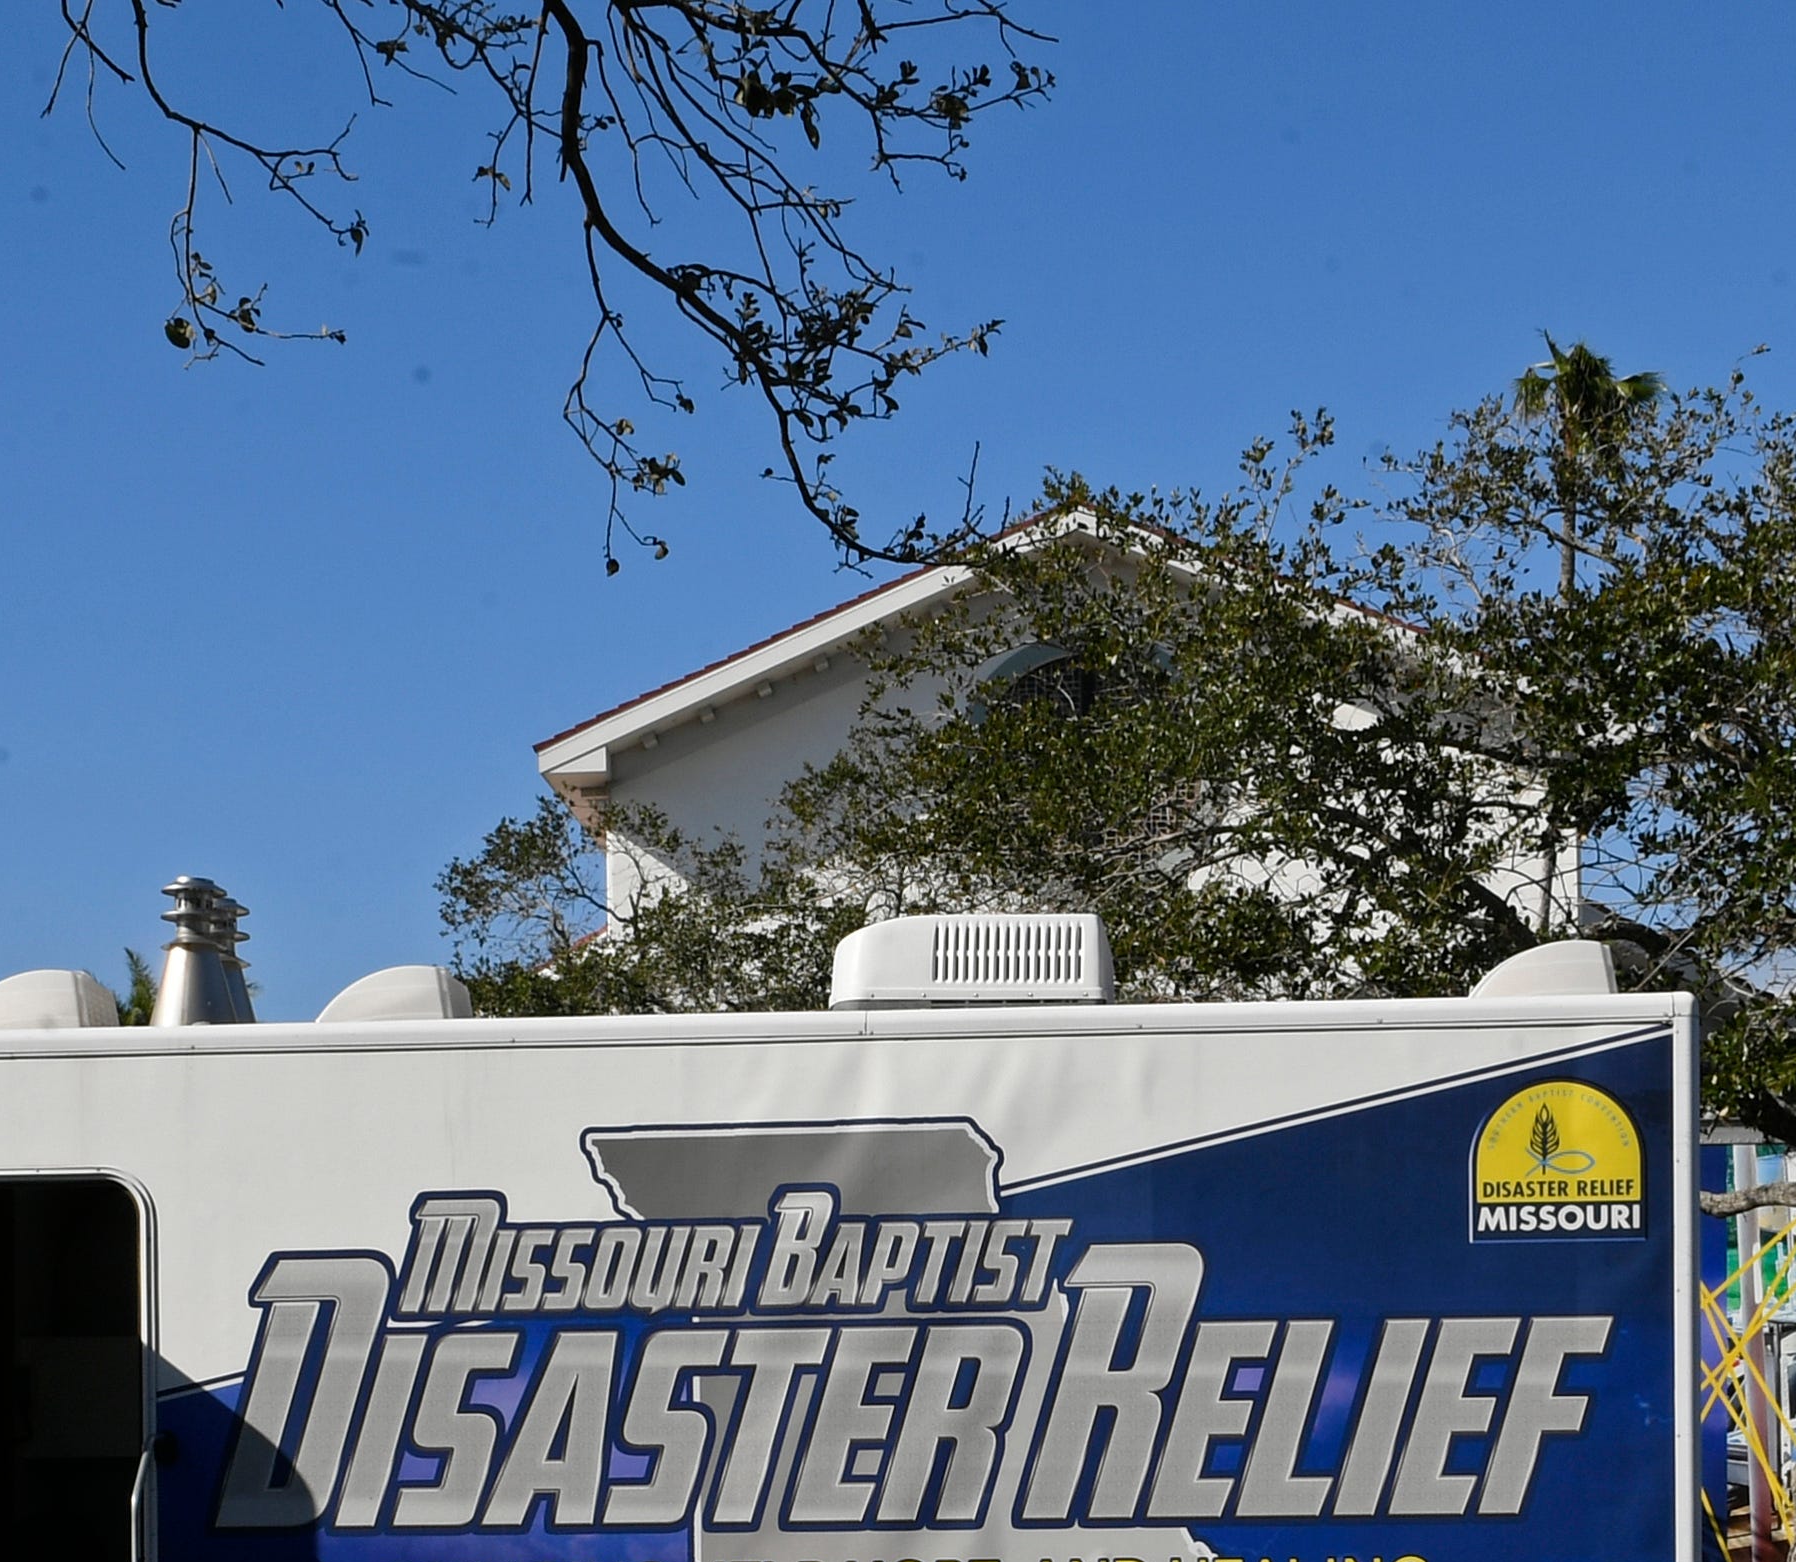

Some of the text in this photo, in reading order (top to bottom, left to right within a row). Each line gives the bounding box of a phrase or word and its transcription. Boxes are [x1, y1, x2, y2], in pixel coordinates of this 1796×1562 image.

[1477, 1204, 1641, 1232] MISSOURI
[1483, 1179, 1635, 1198] DISASTER RELIEF
[404, 1184, 1073, 1320] MISSOURI BAPTIST
[212, 1240, 1616, 1531] DISASTER RELIEF
